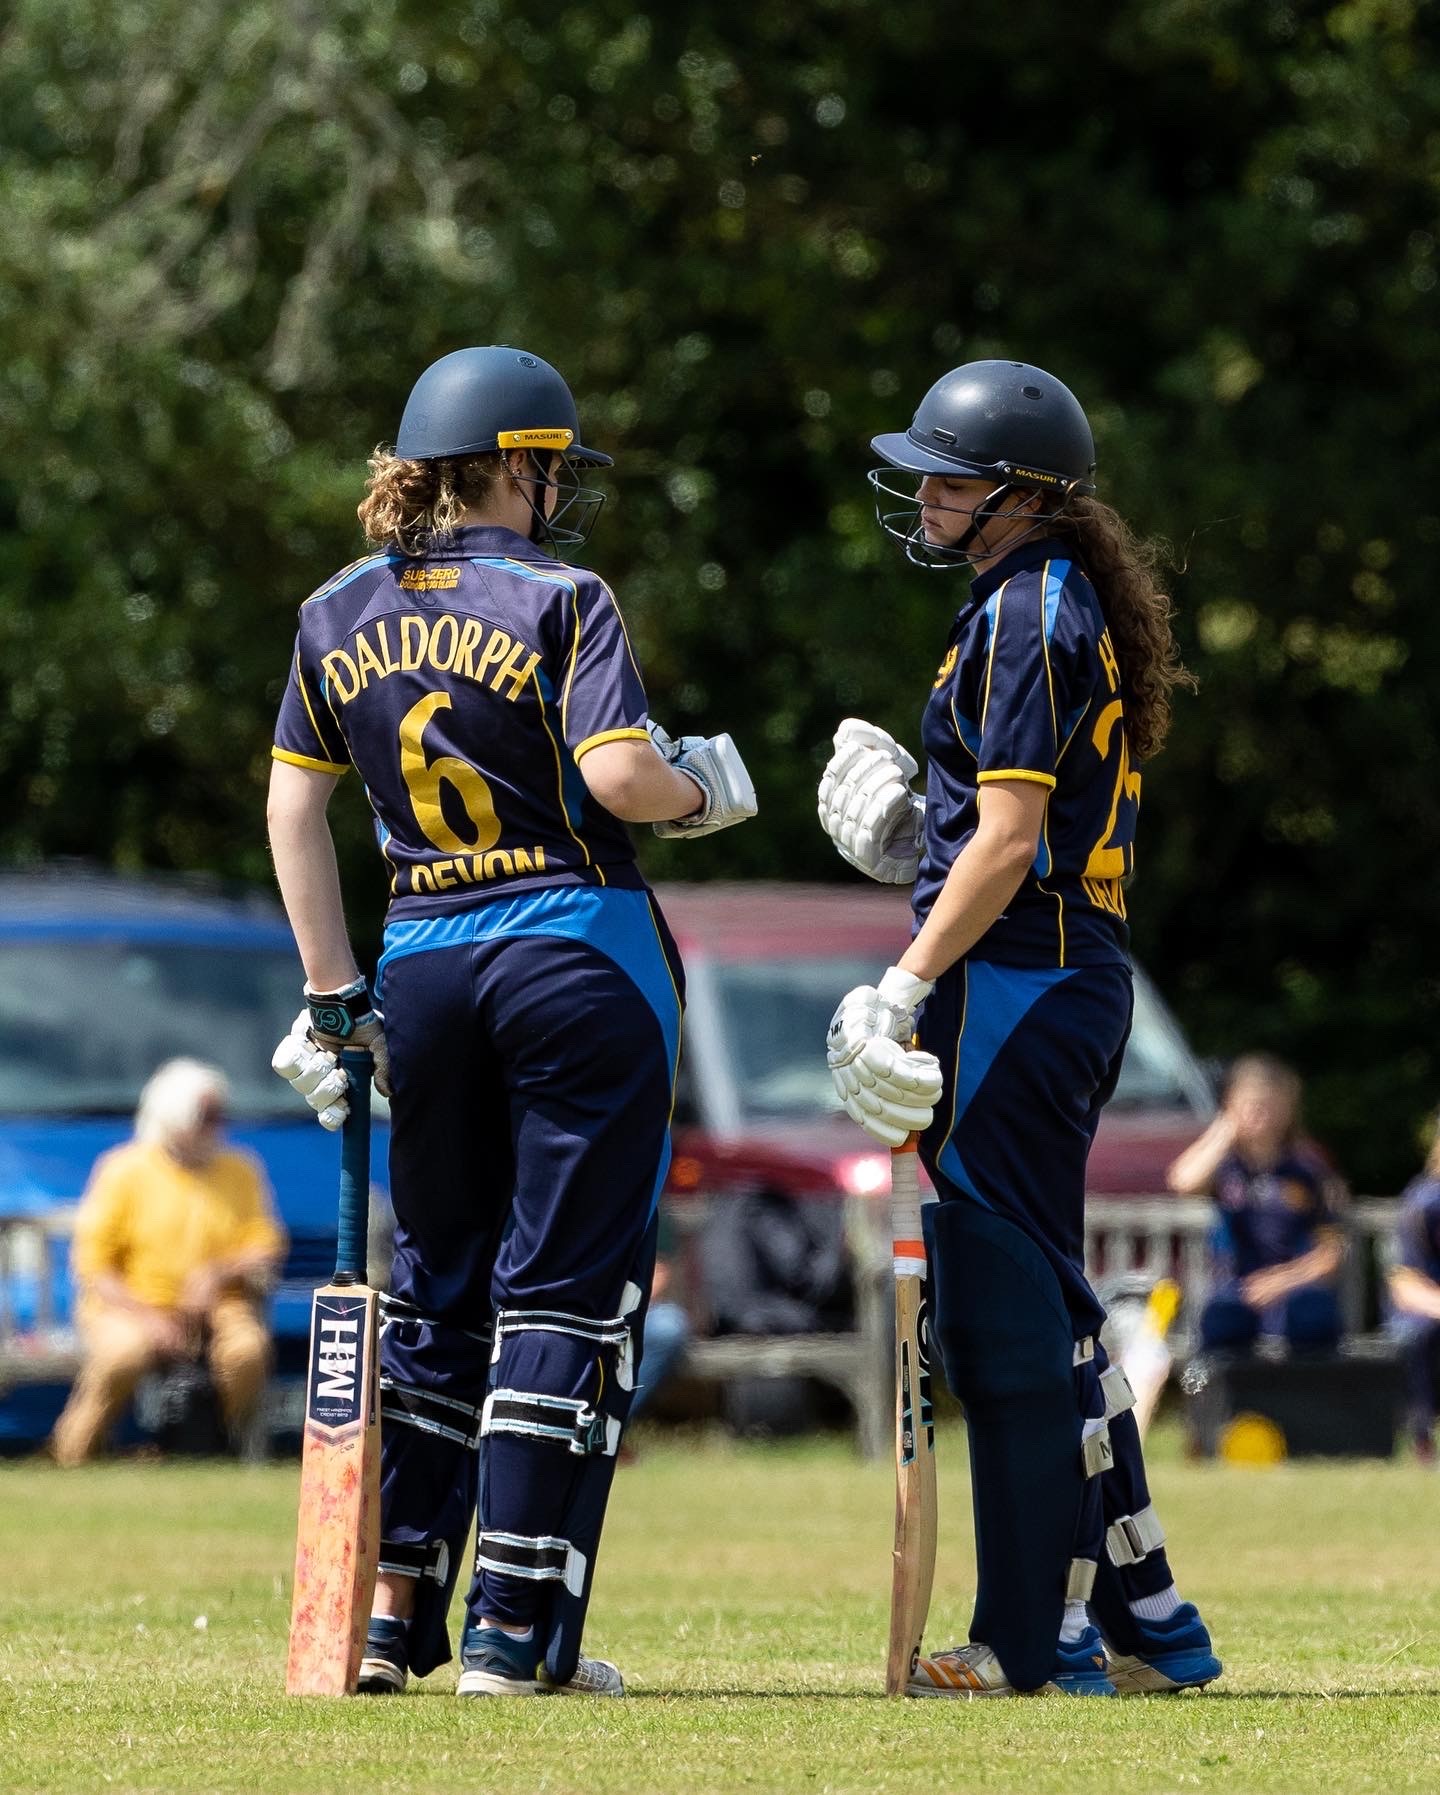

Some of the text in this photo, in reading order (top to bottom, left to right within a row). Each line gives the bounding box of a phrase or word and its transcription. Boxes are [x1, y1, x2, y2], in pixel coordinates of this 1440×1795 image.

[1015, 468, 1057, 484] MASURI
[403, 567, 461, 581] SUB-ZERO
[321, 614, 543, 705] DALDORPH
[399, 691, 502, 855] 6
